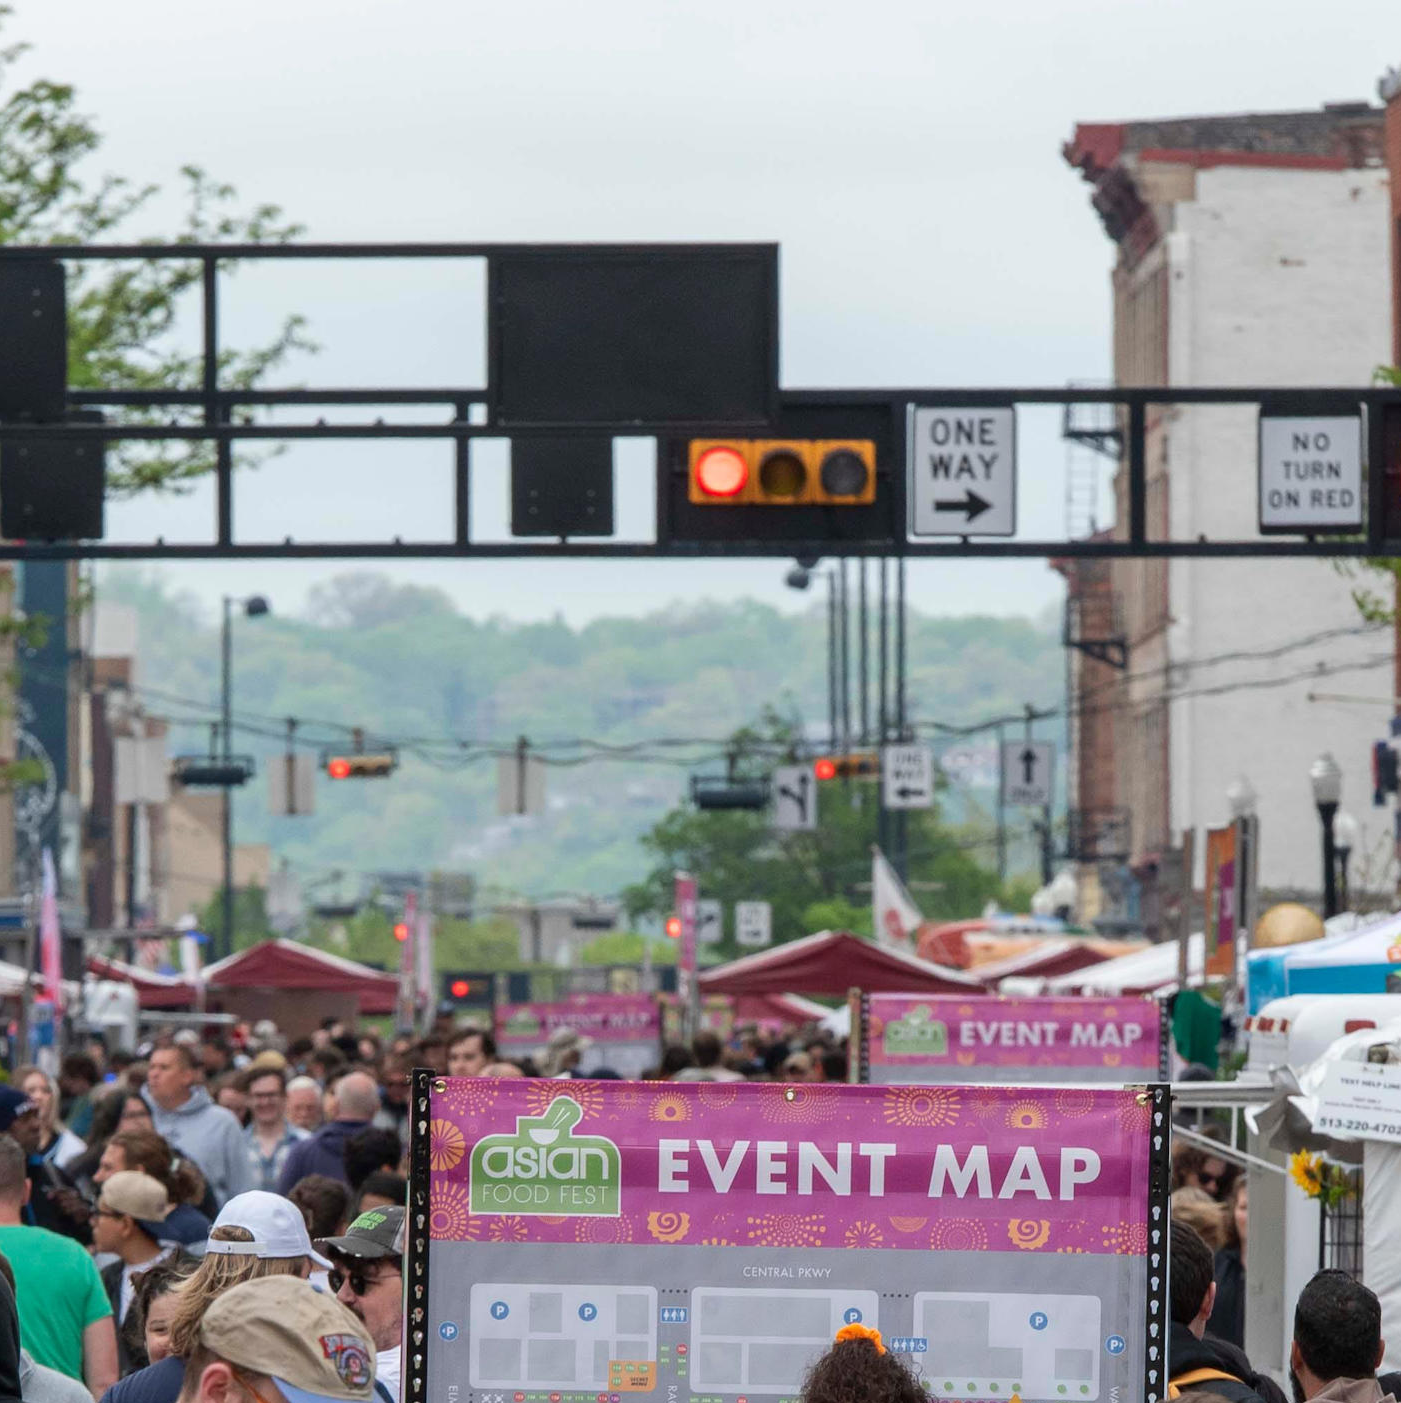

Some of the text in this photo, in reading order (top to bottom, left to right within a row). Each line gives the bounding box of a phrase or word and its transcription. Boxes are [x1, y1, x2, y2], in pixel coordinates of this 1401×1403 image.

[929, 418, 997, 446] ONE
[1292, 432, 1331, 453] NO
[929, 453, 1000, 480] WAY
[1282, 460, 1342, 481] TURN
[1268, 488, 1355, 510] ON RED
[959, 1020, 1143, 1048] EVENT MAP
[482, 1146, 609, 1180] asian
[658, 1138, 1101, 1201] EVENT MAP
[482, 1184, 609, 1205] FOOD FEST
[742, 1265, 832, 1279] CENTRAL PKWY
